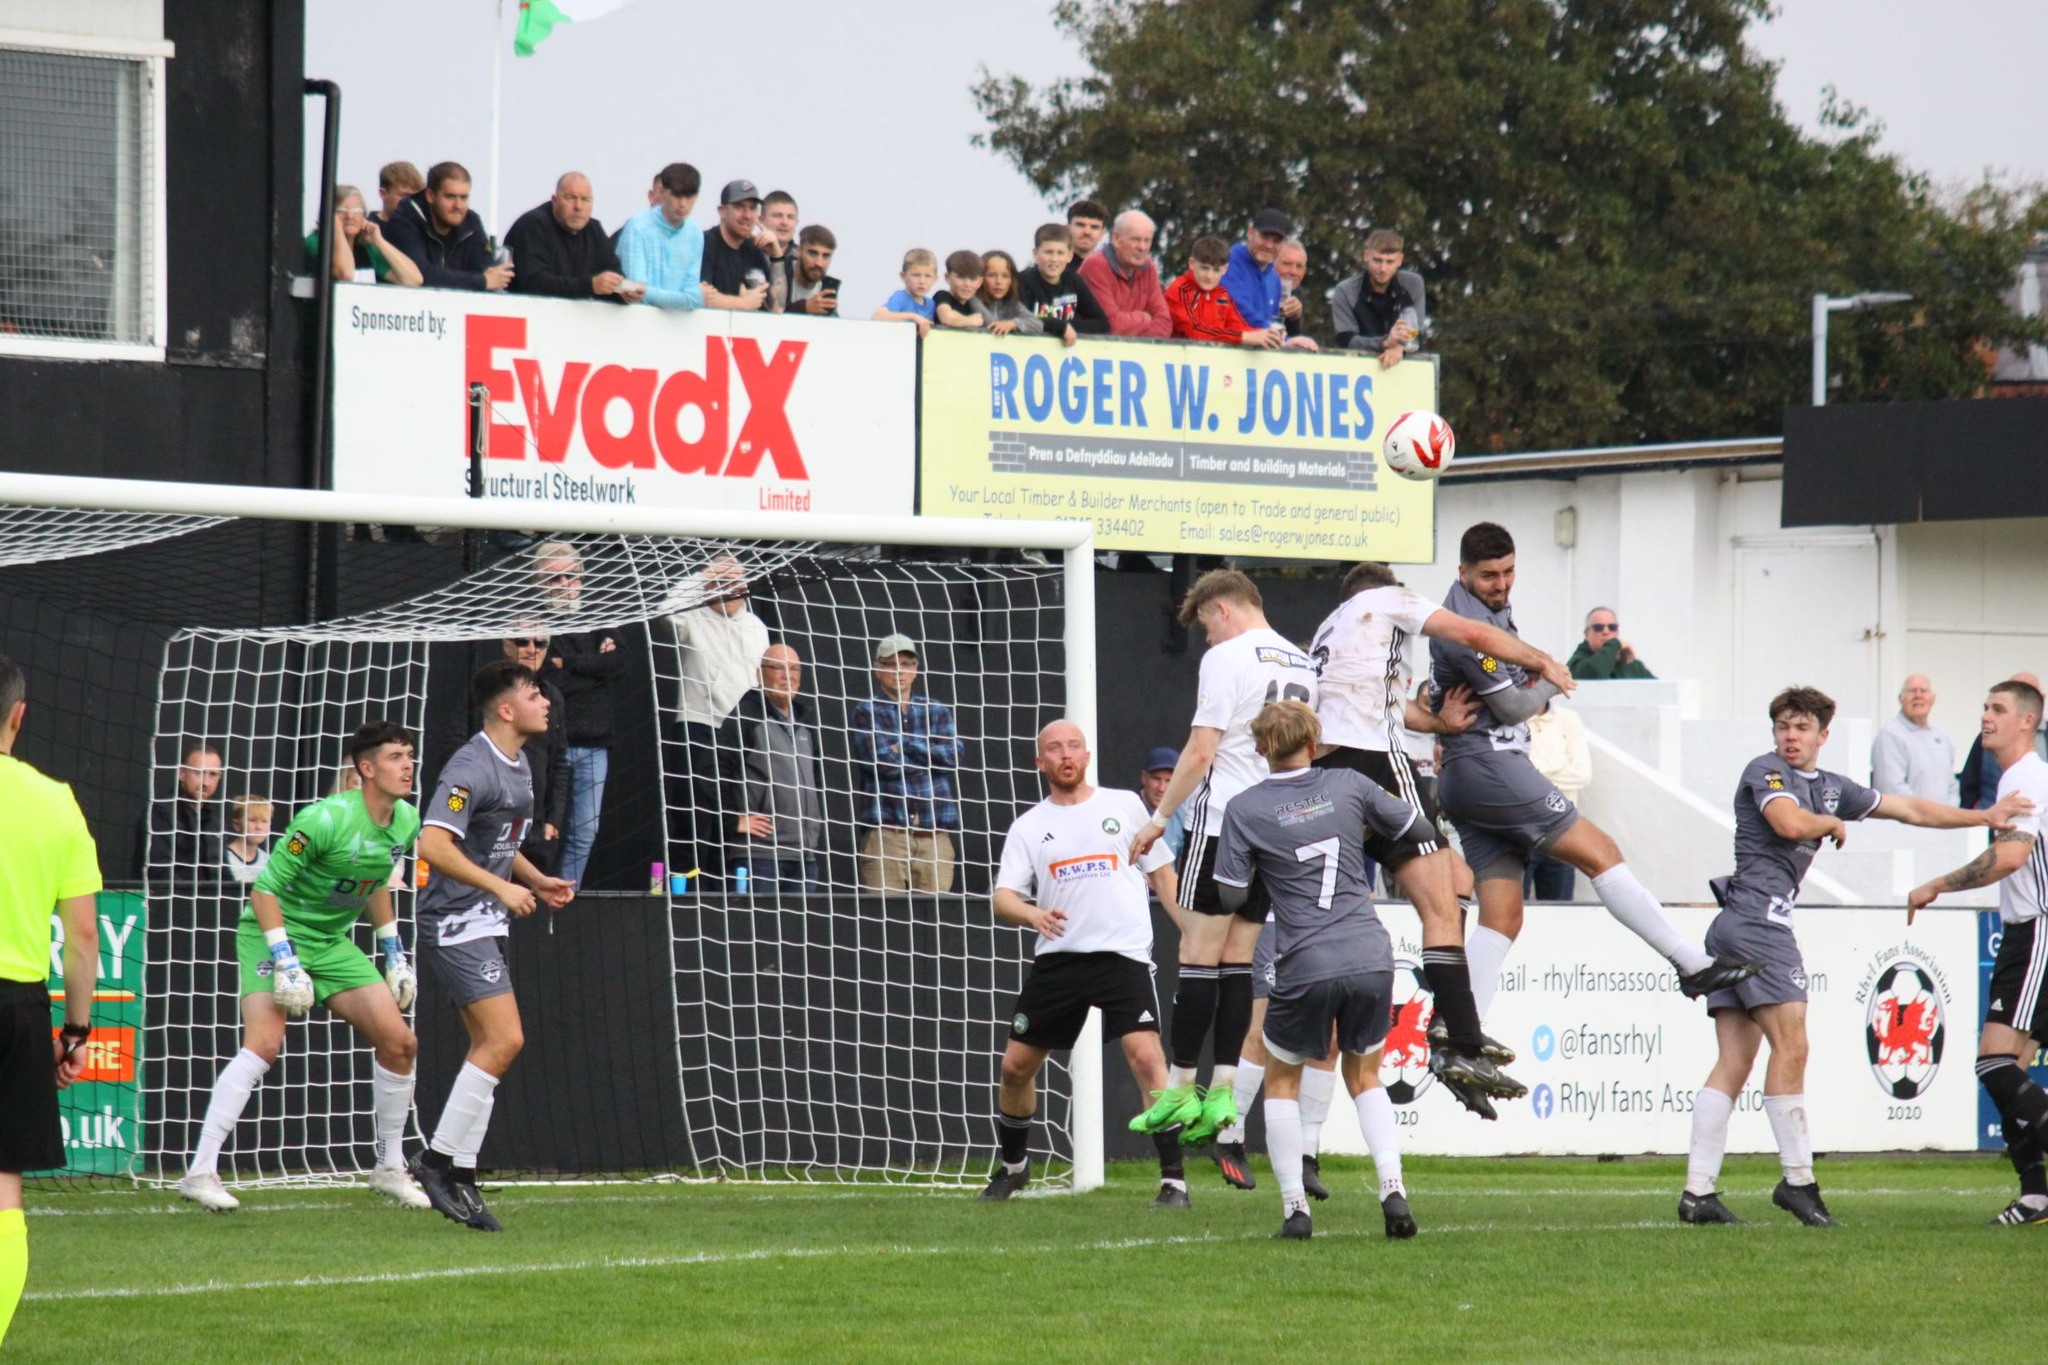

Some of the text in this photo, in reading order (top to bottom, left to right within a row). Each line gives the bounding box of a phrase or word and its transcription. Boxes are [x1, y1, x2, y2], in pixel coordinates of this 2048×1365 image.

[352, 305, 424, 335] Sponsored
[465, 314, 809, 480] EvadX
[990, 352, 1374, 441] ROGER W. JONES
[1029, 446, 1174, 468] Pren a Defnyddiau Adeiladu
[1189, 455, 1346, 478] Timber and Building Materials
[465, 468, 635, 504] Sructural Steelwork
[760, 487, 810, 512] Limited
[950, 485, 1400, 526] Your Local Timber & Builder Merchants (open to Trade and general public)
[1097, 517, 1368, 549] 334402 Email: sales@rogerwjones.co.uk
[1295, 836, 1340, 910] 7
[1560, 1024, 1662, 1063] @fansrhyl
[1560, 1081, 1605, 1121] Rhyl
[1612, 1081, 1653, 1112] fans
[1887, 1106, 1922, 1120] 2020
